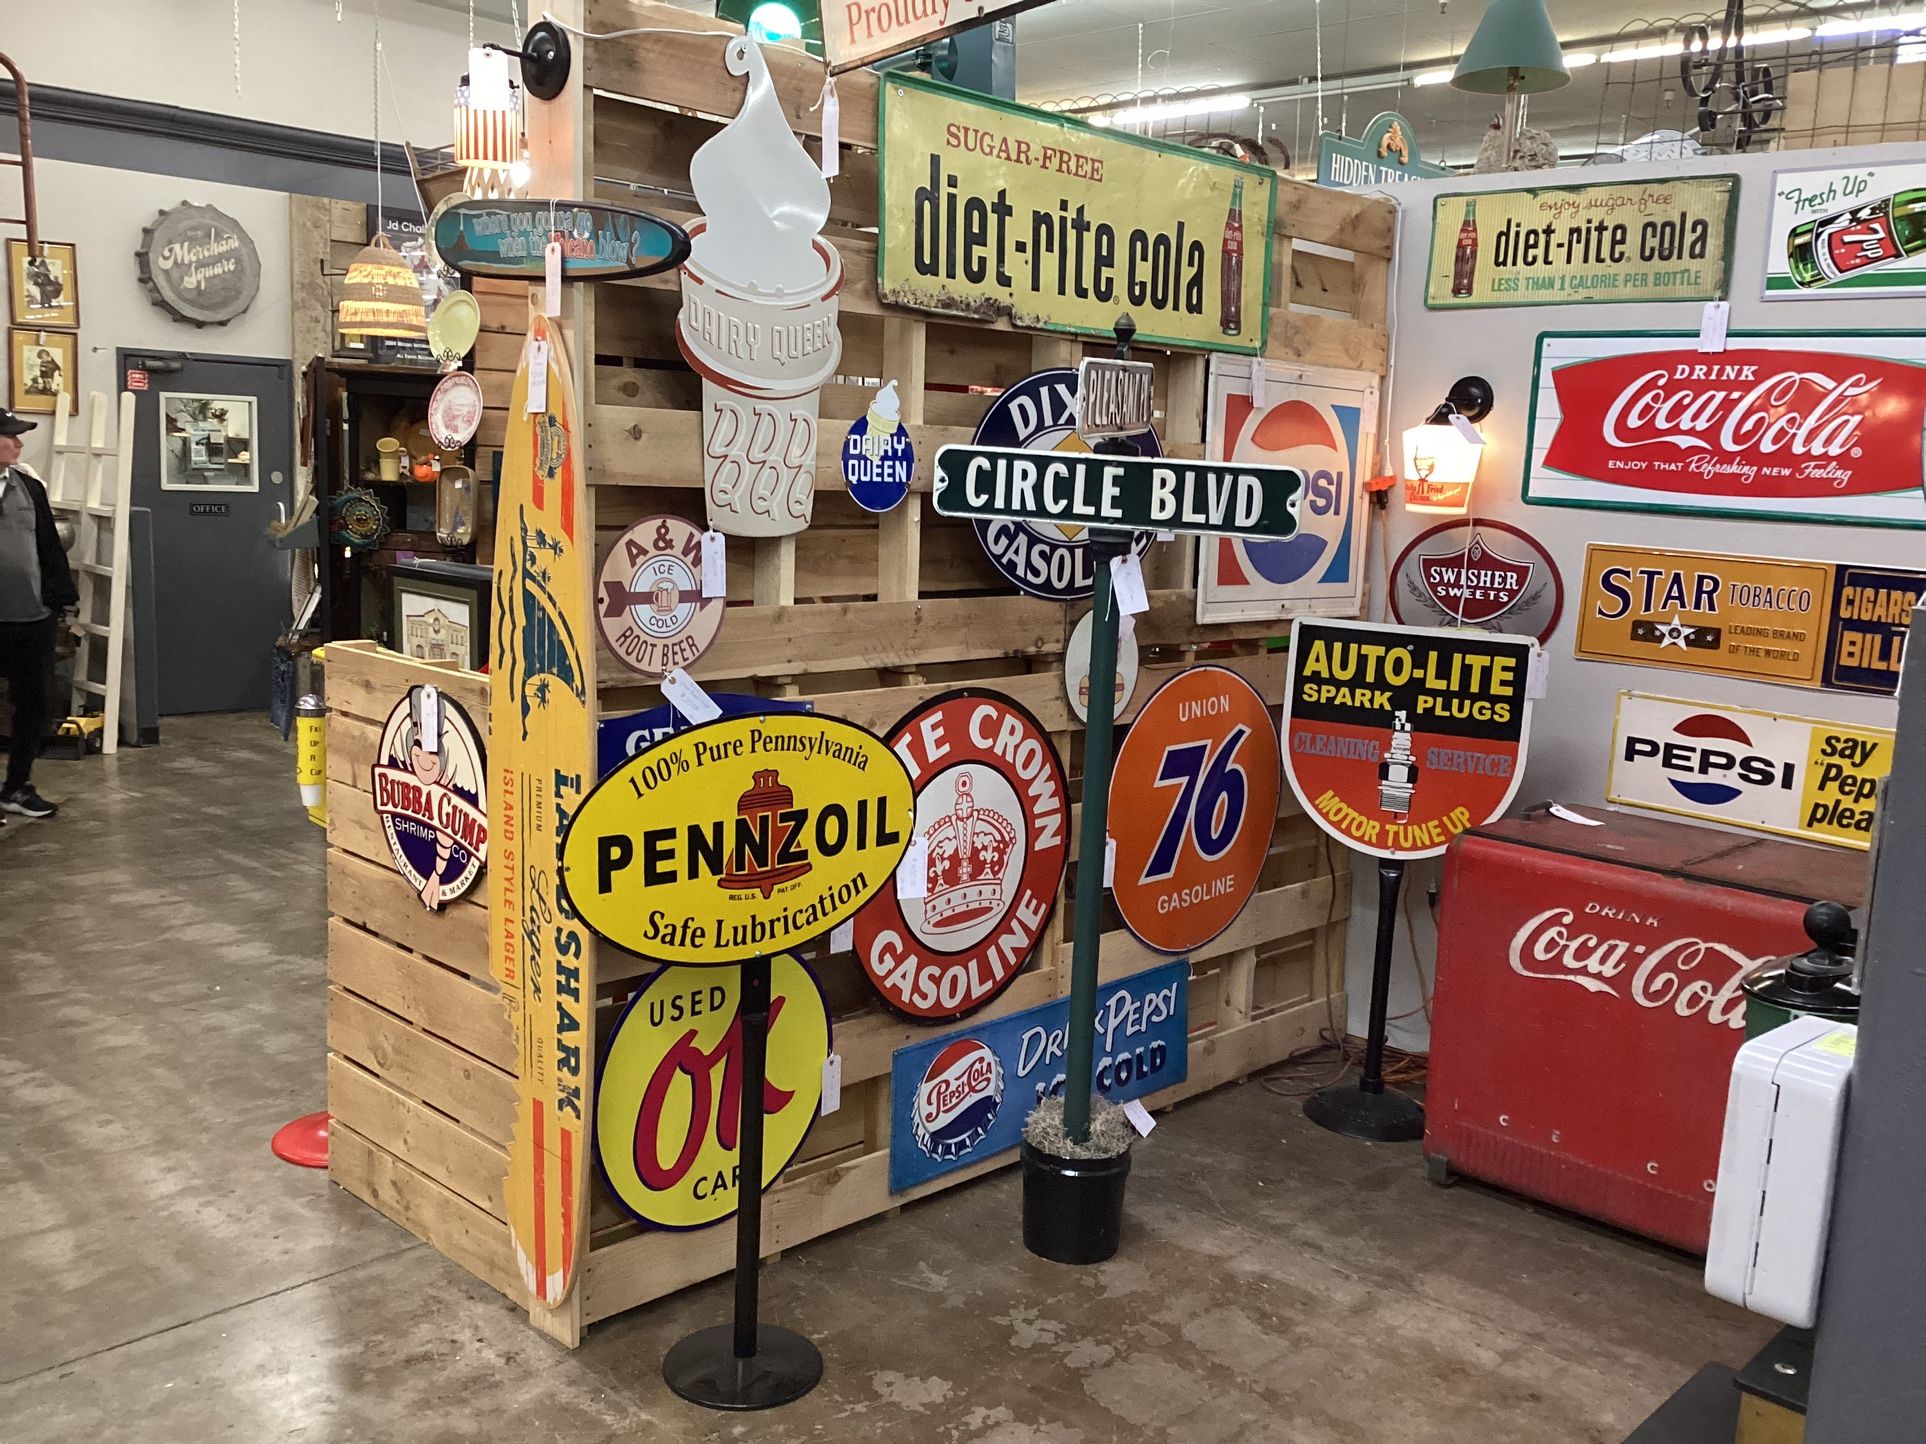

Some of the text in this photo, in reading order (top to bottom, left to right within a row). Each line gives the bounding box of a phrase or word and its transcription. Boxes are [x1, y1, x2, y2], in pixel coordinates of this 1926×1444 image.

[946, 122, 1104, 183] SUGAR-FREE
[1331, 153, 1376, 187] HIDDEN
[1539, 187, 1673, 220] enjoy sugar free
[158, 227, 239, 270] Merchant
[914, 152, 1204, 315] diet-rite cola
[1494, 211, 1709, 268] diet-rite cola
[182, 258, 236, 290] Square
[1491, 270, 1702, 293] LESS THAN 1 CALORIE PER BOTTLE
[688, 293, 833, 366] DAIRY QUEEN
[1088, 369, 1140, 425] PLEASANT
[1673, 364, 1759, 381] DRINK
[1603, 370, 1884, 458] Coca-Cola
[848, 460, 907, 484] QUEEN
[850, 434, 907, 457] DAIRY
[1608, 454, 1852, 488] ENJOY THAT Refreshing NEW Feeling
[193, 504, 227, 513] OFFICE
[965, 456, 1264, 527] CIRCLE BLVD
[653, 564, 675, 576] ICE
[1430, 566, 1519, 590] SWISHER
[1437, 586, 1509, 602] SWEETS
[1596, 566, 1811, 621] STAR TOBACCO
[649, 614, 679, 629] COLD
[1728, 624, 1806, 642] LEADING BRAND
[1839, 586, 1917, 625] CIGARS
[615, 626, 700, 667] ROOT BEER
[1303, 639, 1516, 696] AUTO-LITE
[1728, 643, 1800, 662] OF THE WORLD
[1178, 694, 1230, 722] UNION
[1302, 683, 1510, 722] SPARK PLUGS
[628, 748, 690, 800] 100%
[693, 735, 743, 768] Pure
[749, 728, 869, 773] Pennsylvania
[969, 704, 1062, 851] CROWN
[1294, 732, 1512, 777] CLEANING SERVICE
[1624, 735, 1878, 790] PEPSI say
[378, 772, 488, 853] BUBBA GUMP
[395, 818, 435, 842] SHRIMP
[503, 768, 514, 841] ISLAND
[1137, 723, 1252, 886] 76
[1315, 789, 1473, 848] MOTOR TUNE UP
[385, 815, 422, 887] RESTAURANT
[449, 863, 477, 895] MARKET
[597, 795, 900, 896] PENNZOIL
[504, 849, 515, 911] STYLE
[1157, 874, 1234, 914] GASOLINE
[643, 910, 706, 949] Safe
[714, 871, 869, 949] Lubrication
[1585, 902, 1660, 927] DRINK
[504, 919, 515, 980] LAGER
[869, 888, 1047, 1010] GASOLINE
[649, 986, 727, 1027] USED
[1104, 981, 1178, 1053] PEPSI
[632, 995, 796, 1191] OK
[925, 1056, 992, 1123] PEPSI-COLA
[1095, 1039, 1167, 1094] COLD
